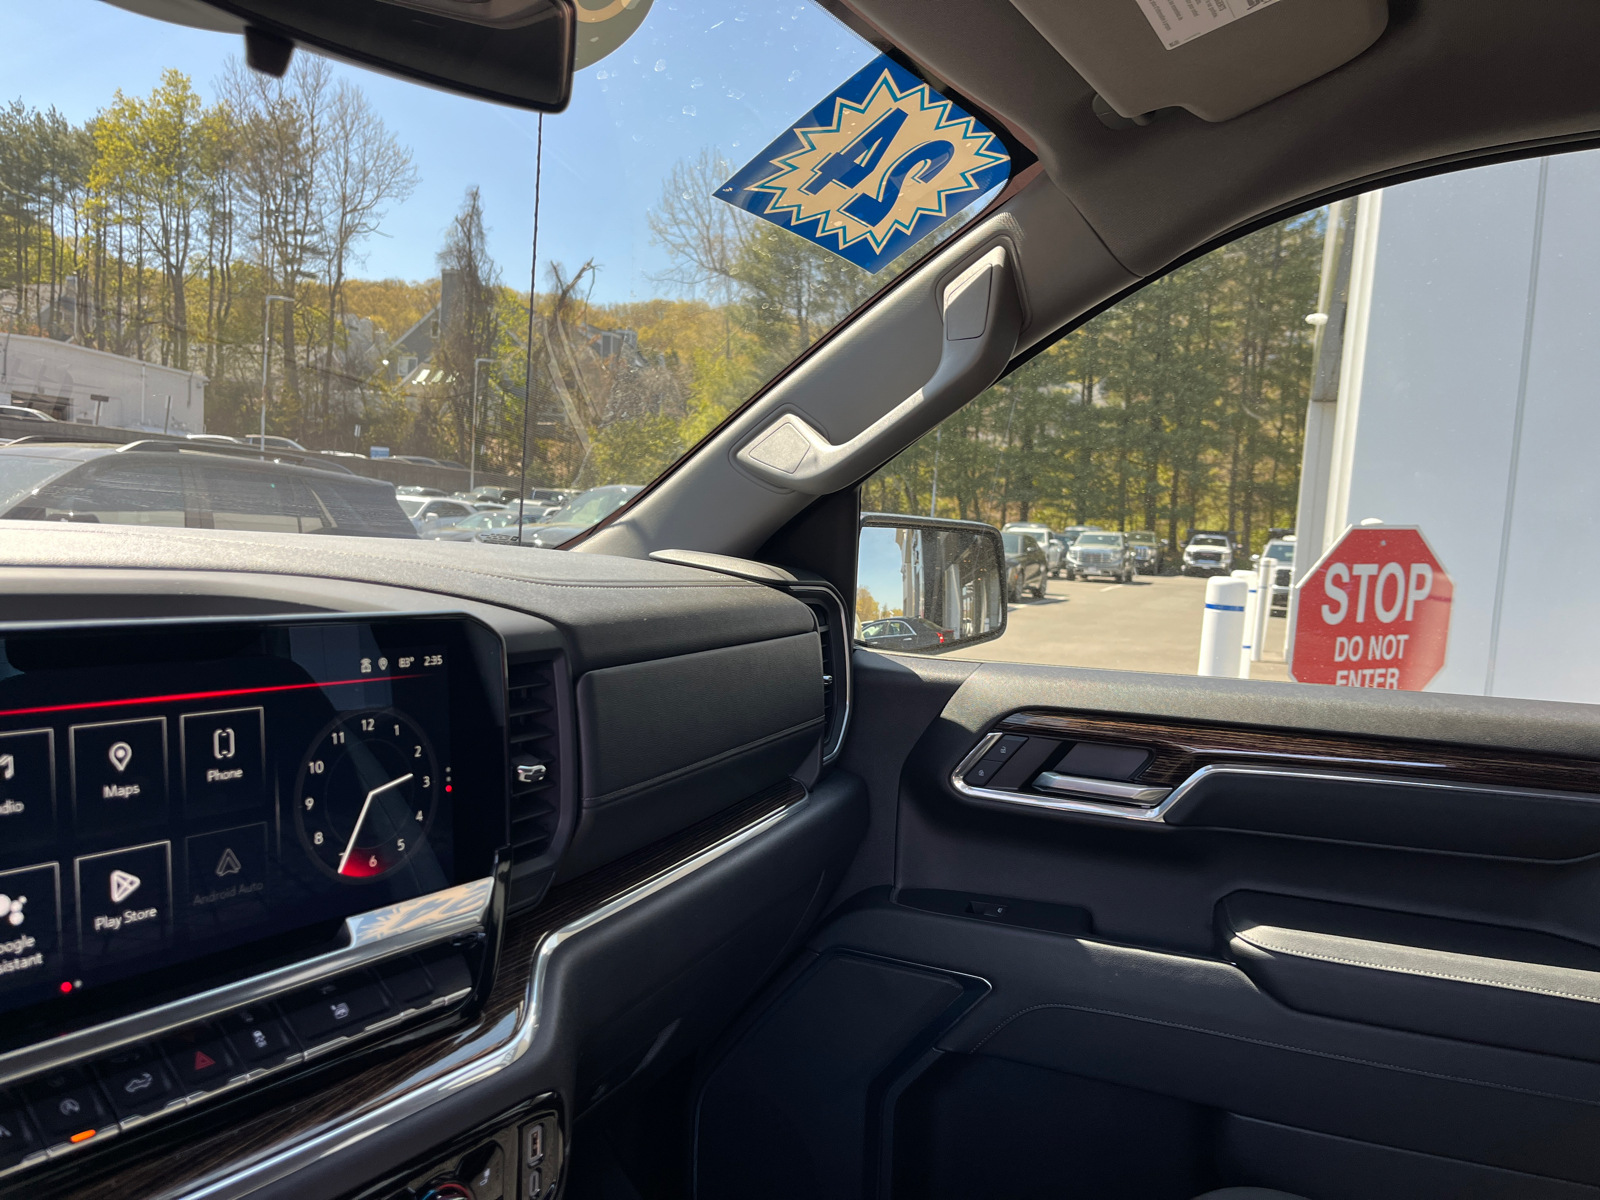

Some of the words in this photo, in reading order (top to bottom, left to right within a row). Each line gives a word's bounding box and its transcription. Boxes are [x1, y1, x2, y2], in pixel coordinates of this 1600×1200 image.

[1321, 562, 1434, 626] STOP
[1333, 635, 1364, 662] DO
[1367, 634, 1410, 661] NOT
[1335, 667, 1400, 691] ENTER
[361, 718, 375, 731] 12
[393, 724, 400, 736] 1
[331, 731, 345, 745] 11
[414, 745, 422, 758] 2
[308, 760, 325, 774] 10
[206, 768, 244, 782] Phone
[422, 775, 431, 788] 3
[103, 783, 141, 799] Maps
[0, 799, 25, 815] dio
[304, 797, 315, 811] 9
[415, 810, 424, 822] 4
[313, 831, 324, 845] 8
[396, 838, 406, 851] 5
[368, 855, 378, 868] 6
[193, 884, 237, 906] Android
[238, 881, 265, 895] Auto
[94, 915, 122, 932] Play
[123, 906, 158, 924] Store
[0, 933, 36, 955] oogle
[0, 952, 44, 975] sistant
